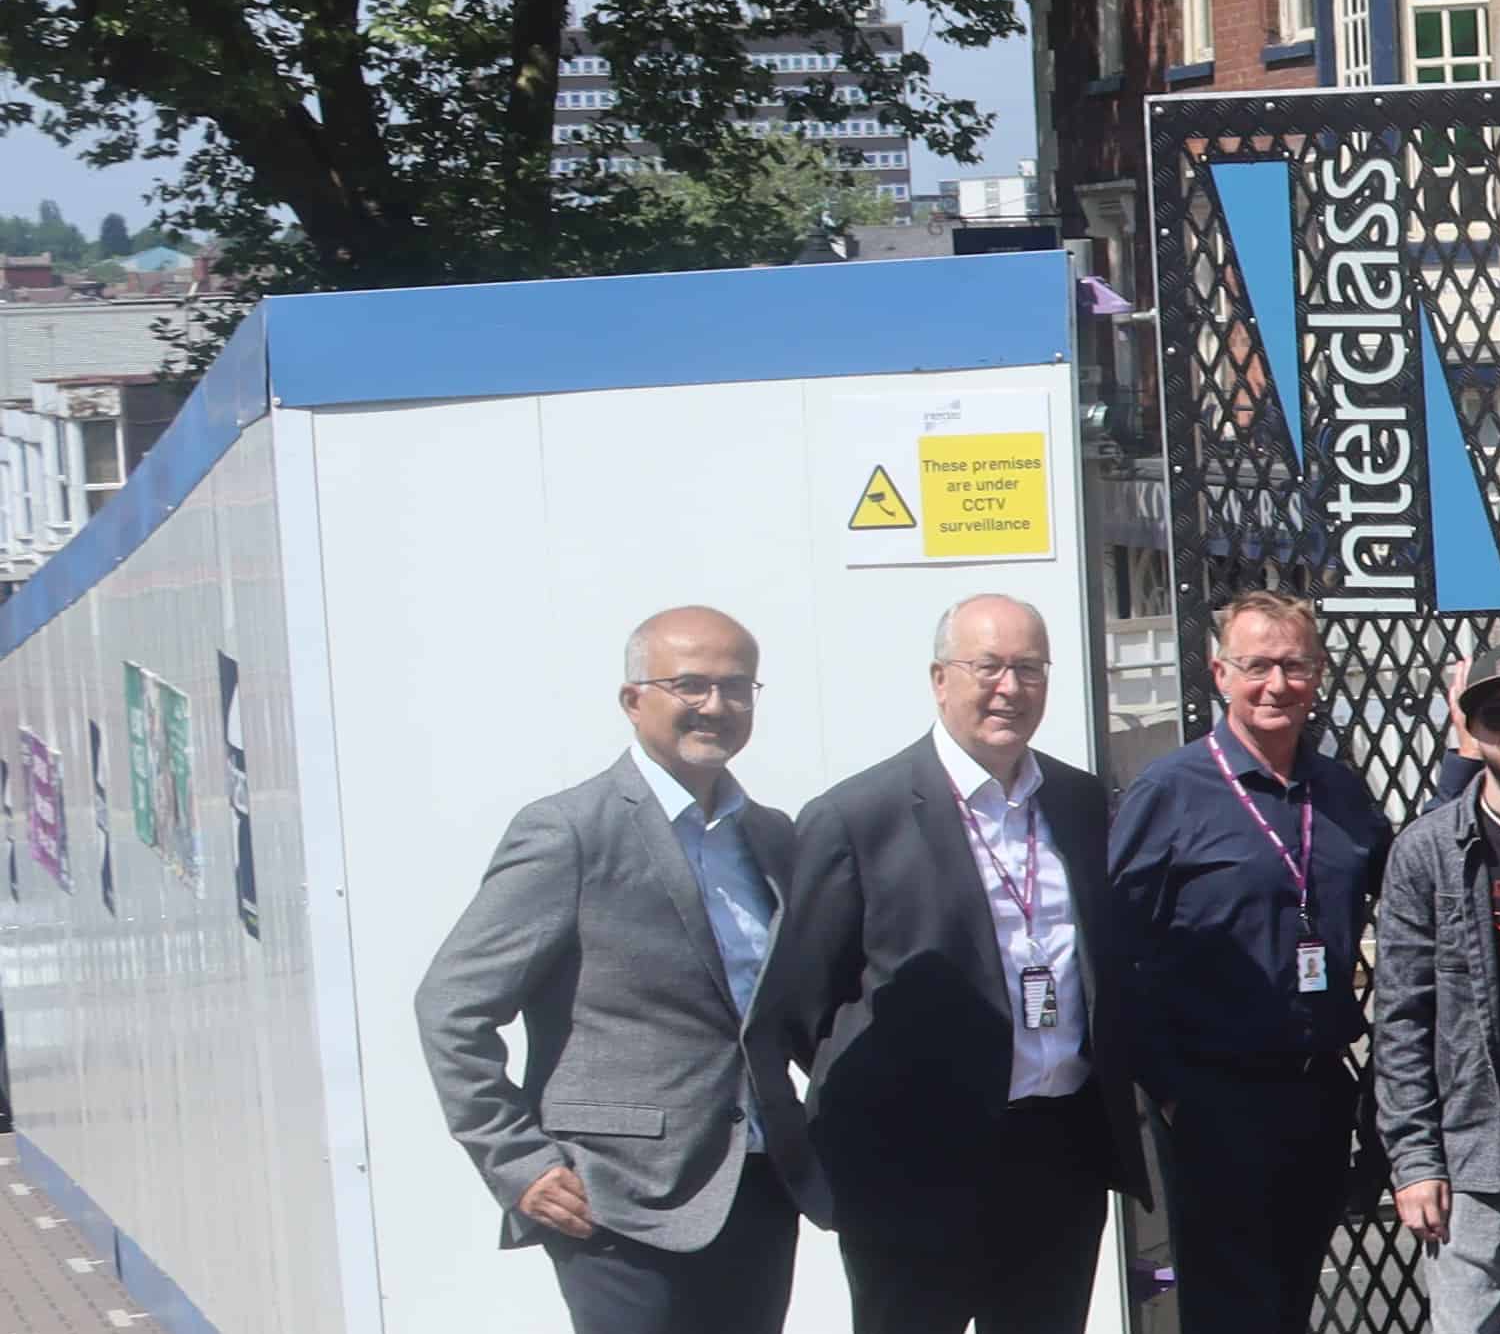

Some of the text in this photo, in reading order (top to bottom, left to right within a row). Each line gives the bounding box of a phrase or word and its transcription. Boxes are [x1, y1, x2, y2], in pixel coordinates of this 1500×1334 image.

[1307, 158, 1418, 613] Interclass
[922, 456, 1042, 475] These premises
[947, 478, 1019, 493] are under
[962, 498, 1006, 512] CCTV
[939, 518, 1031, 534] surveillance
